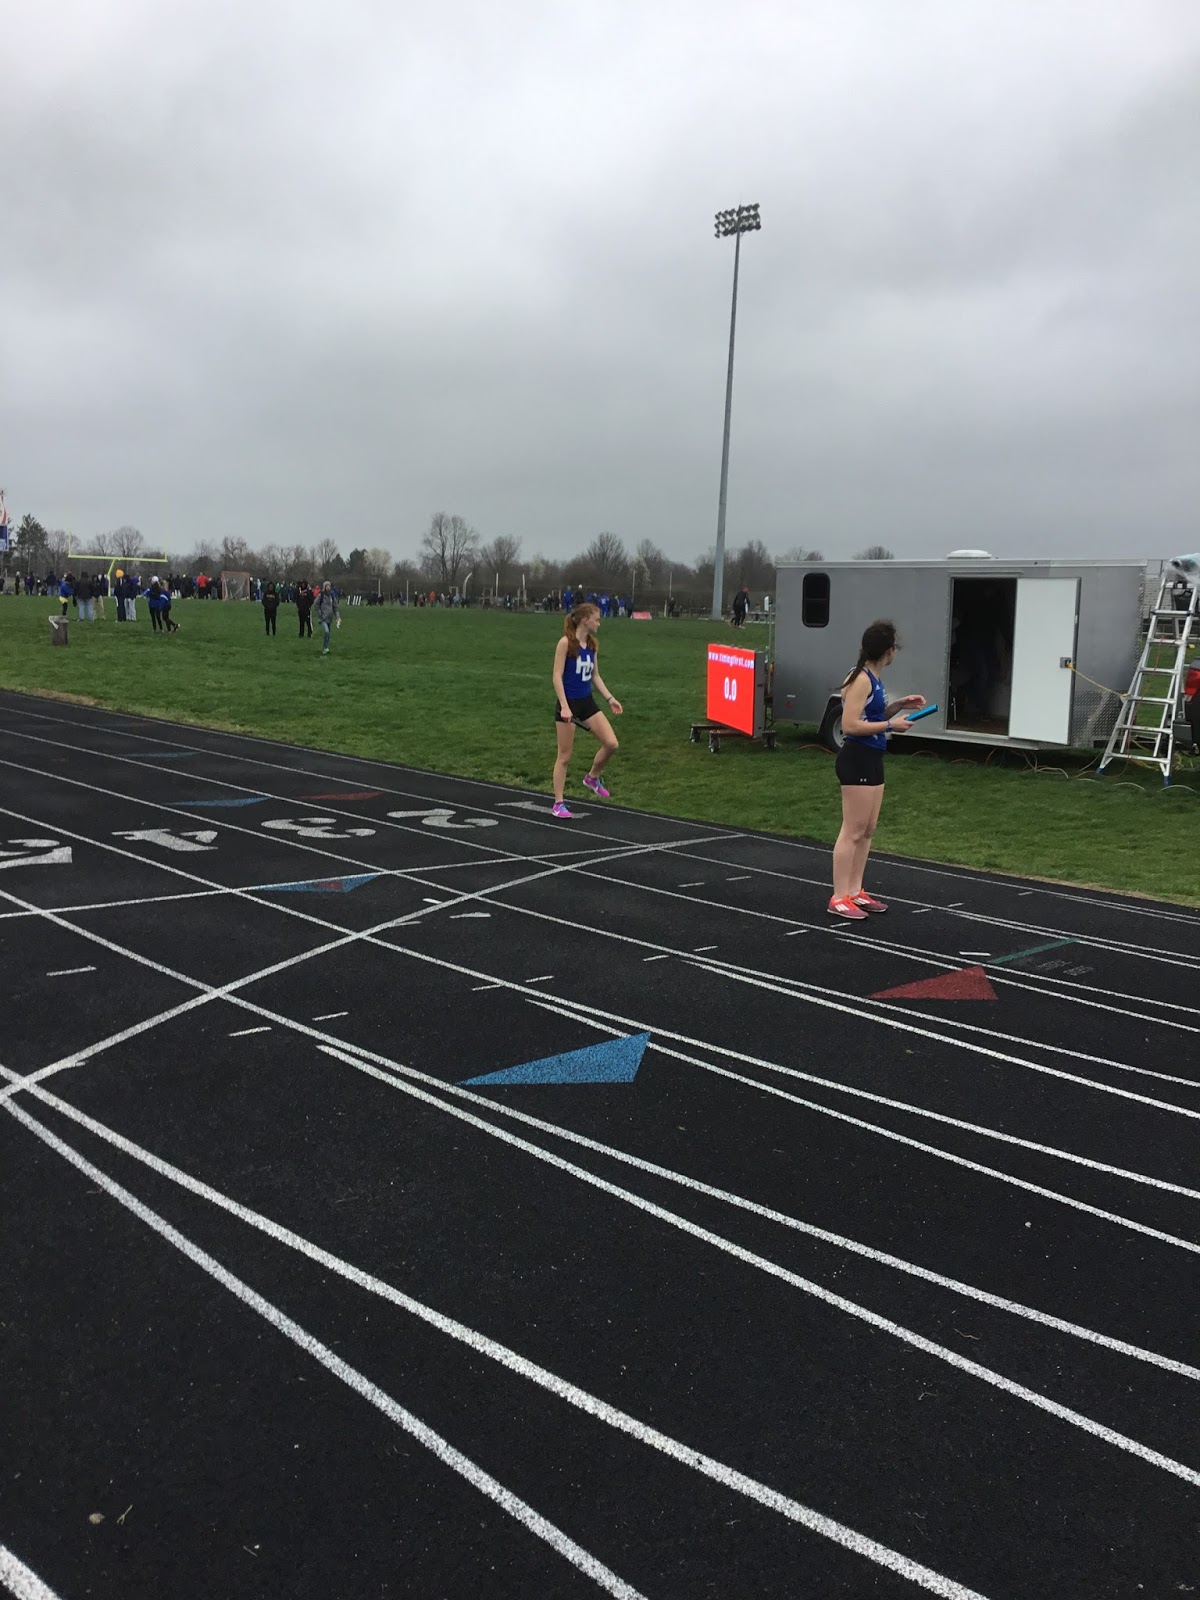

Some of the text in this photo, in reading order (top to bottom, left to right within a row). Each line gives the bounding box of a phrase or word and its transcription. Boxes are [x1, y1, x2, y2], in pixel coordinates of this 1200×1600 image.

[724, 677, 737, 701] 0.0
[260, 817, 376, 839] 3
[386, 808, 499, 829] 2
[111, 828, 218, 851] 4
